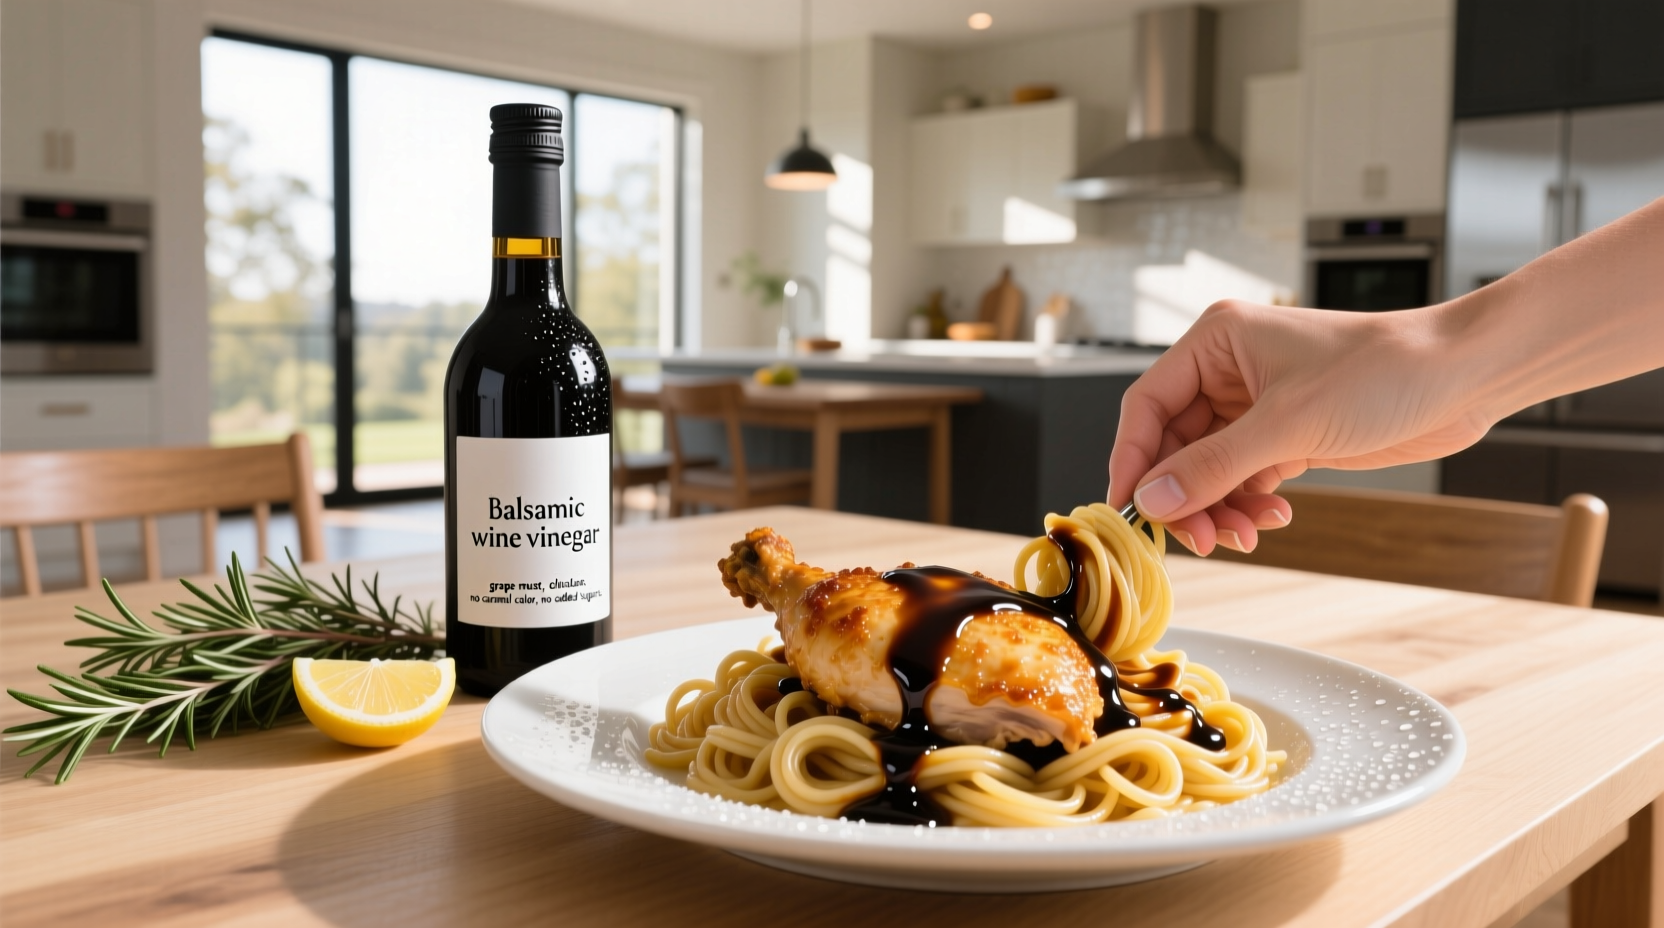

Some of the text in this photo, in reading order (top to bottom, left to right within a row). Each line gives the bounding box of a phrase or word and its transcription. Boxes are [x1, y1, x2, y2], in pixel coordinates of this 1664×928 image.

[489, 496, 585, 520] Balsamic
[471, 526, 600, 552] wine vinegar
[489, 582, 516, 593] grape
